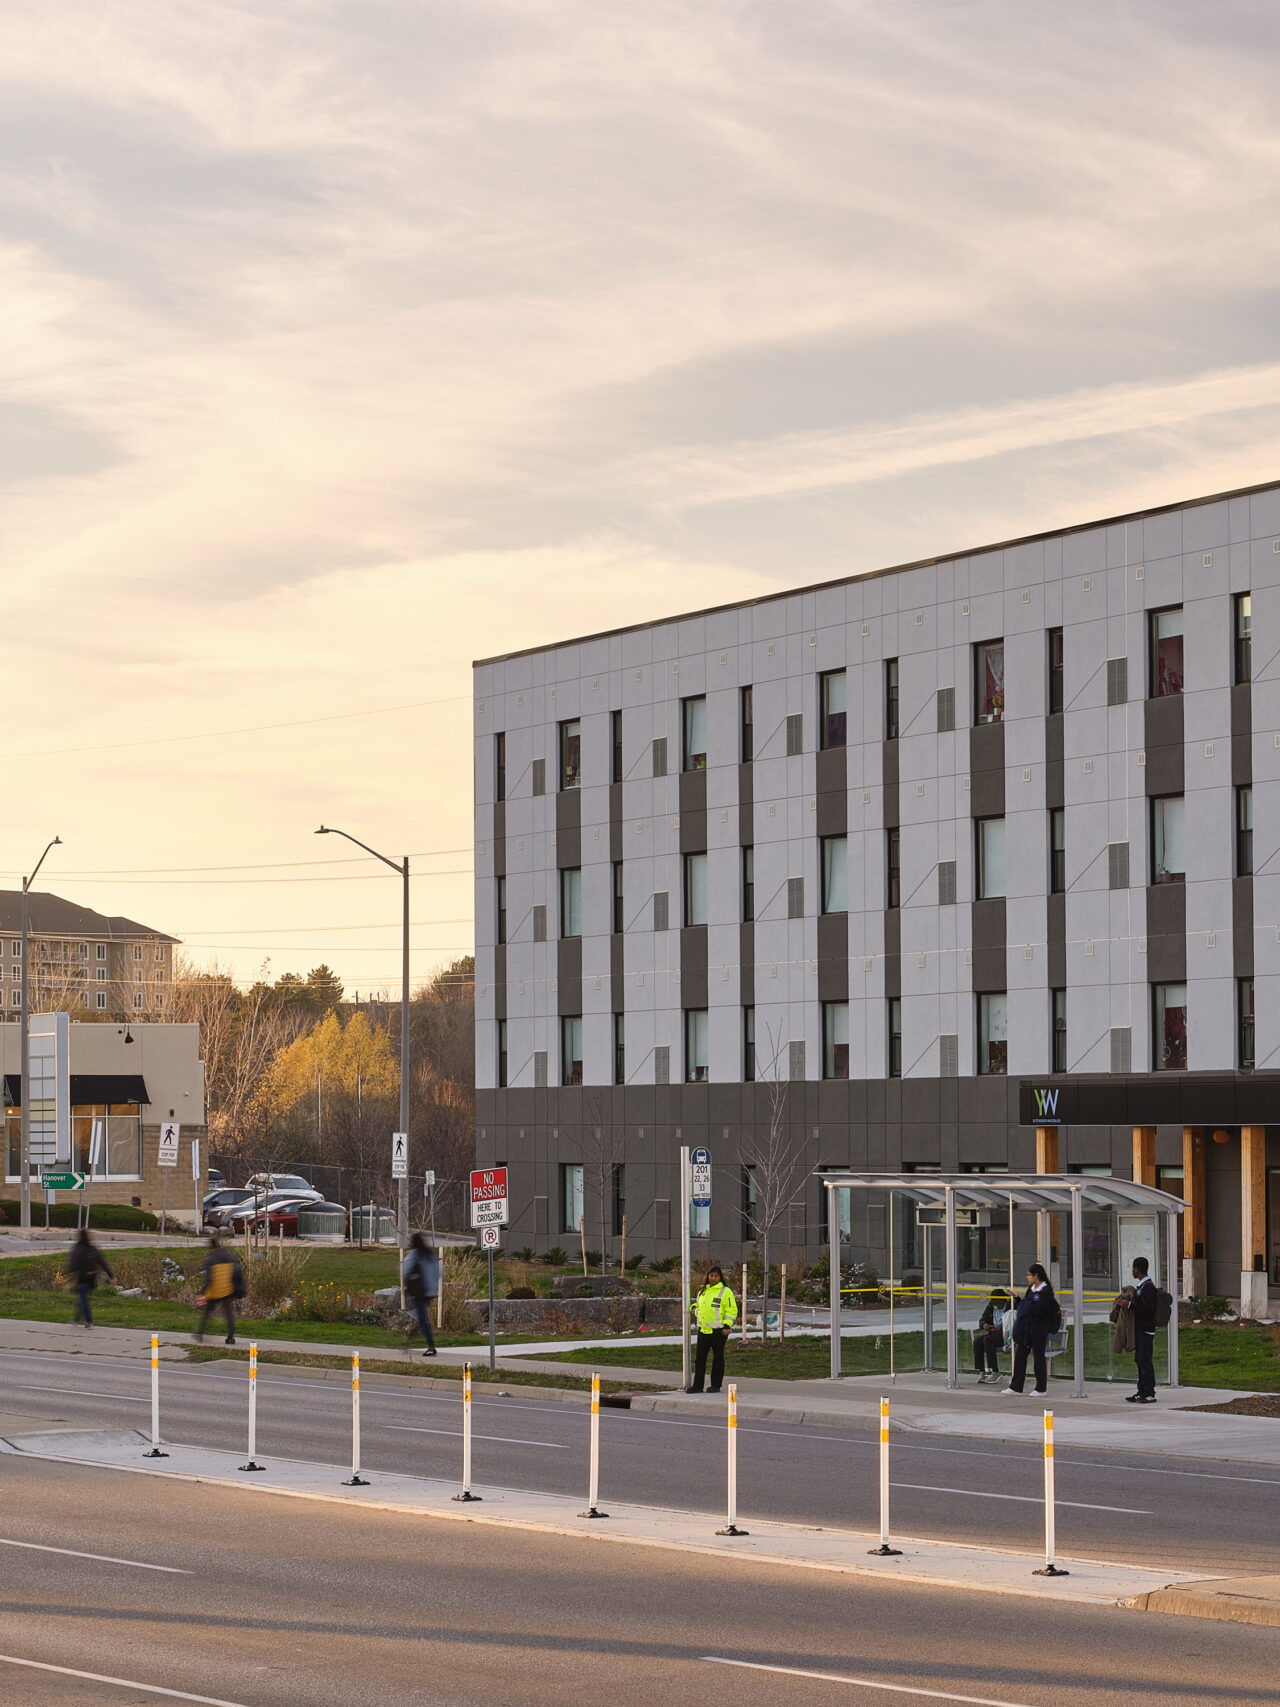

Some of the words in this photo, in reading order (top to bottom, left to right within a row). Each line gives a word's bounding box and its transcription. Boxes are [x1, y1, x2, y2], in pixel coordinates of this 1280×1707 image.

[1034, 1089, 1059, 1116] YW
[696, 1165, 708, 1174] 201
[483, 1172, 495, 1185] NO
[473, 1184, 505, 1200] PASSING
[477, 1202, 492, 1213] HERE
[494, 1201, 502, 1210] TO
[476, 1212, 503, 1223] CROSSING
